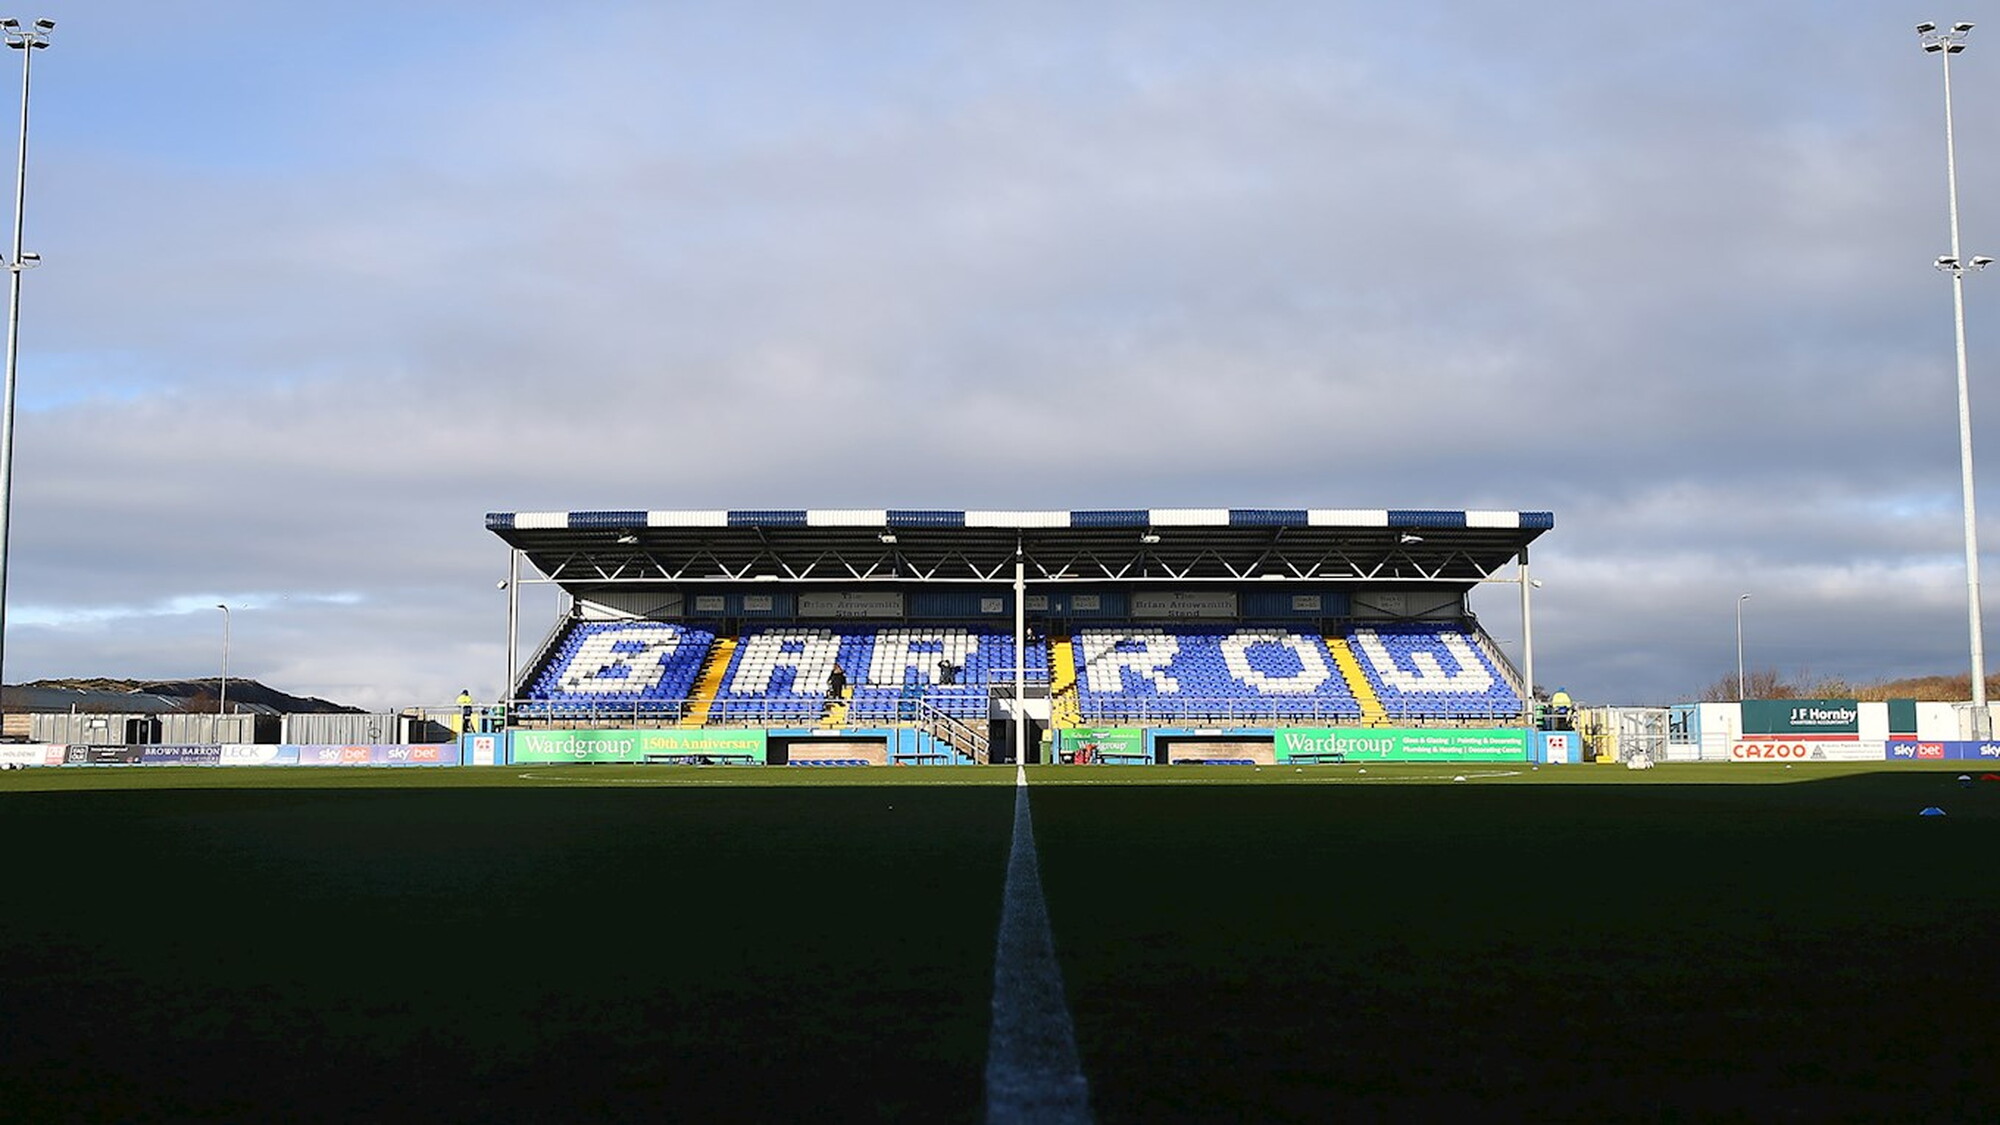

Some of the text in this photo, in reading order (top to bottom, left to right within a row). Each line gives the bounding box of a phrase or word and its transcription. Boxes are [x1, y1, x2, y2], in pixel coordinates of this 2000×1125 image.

[1135, 601, 1165, 609] Brian
[556, 627, 1495, 696] BARROW
[1790, 708, 1857, 722] J F Hornby
[223, 746, 259, 757] LECK
[524, 735, 633, 757] Wardgroup
[643, 737, 760, 752] 150th Anniversary
[1284, 733, 1394, 757] Wardgroup
[1733, 744, 1807, 758] CAZOO
[1893, 743, 1941, 757] sky bet
[318, 747, 367, 761] sky bet
[388, 747, 436, 760] sky bet
